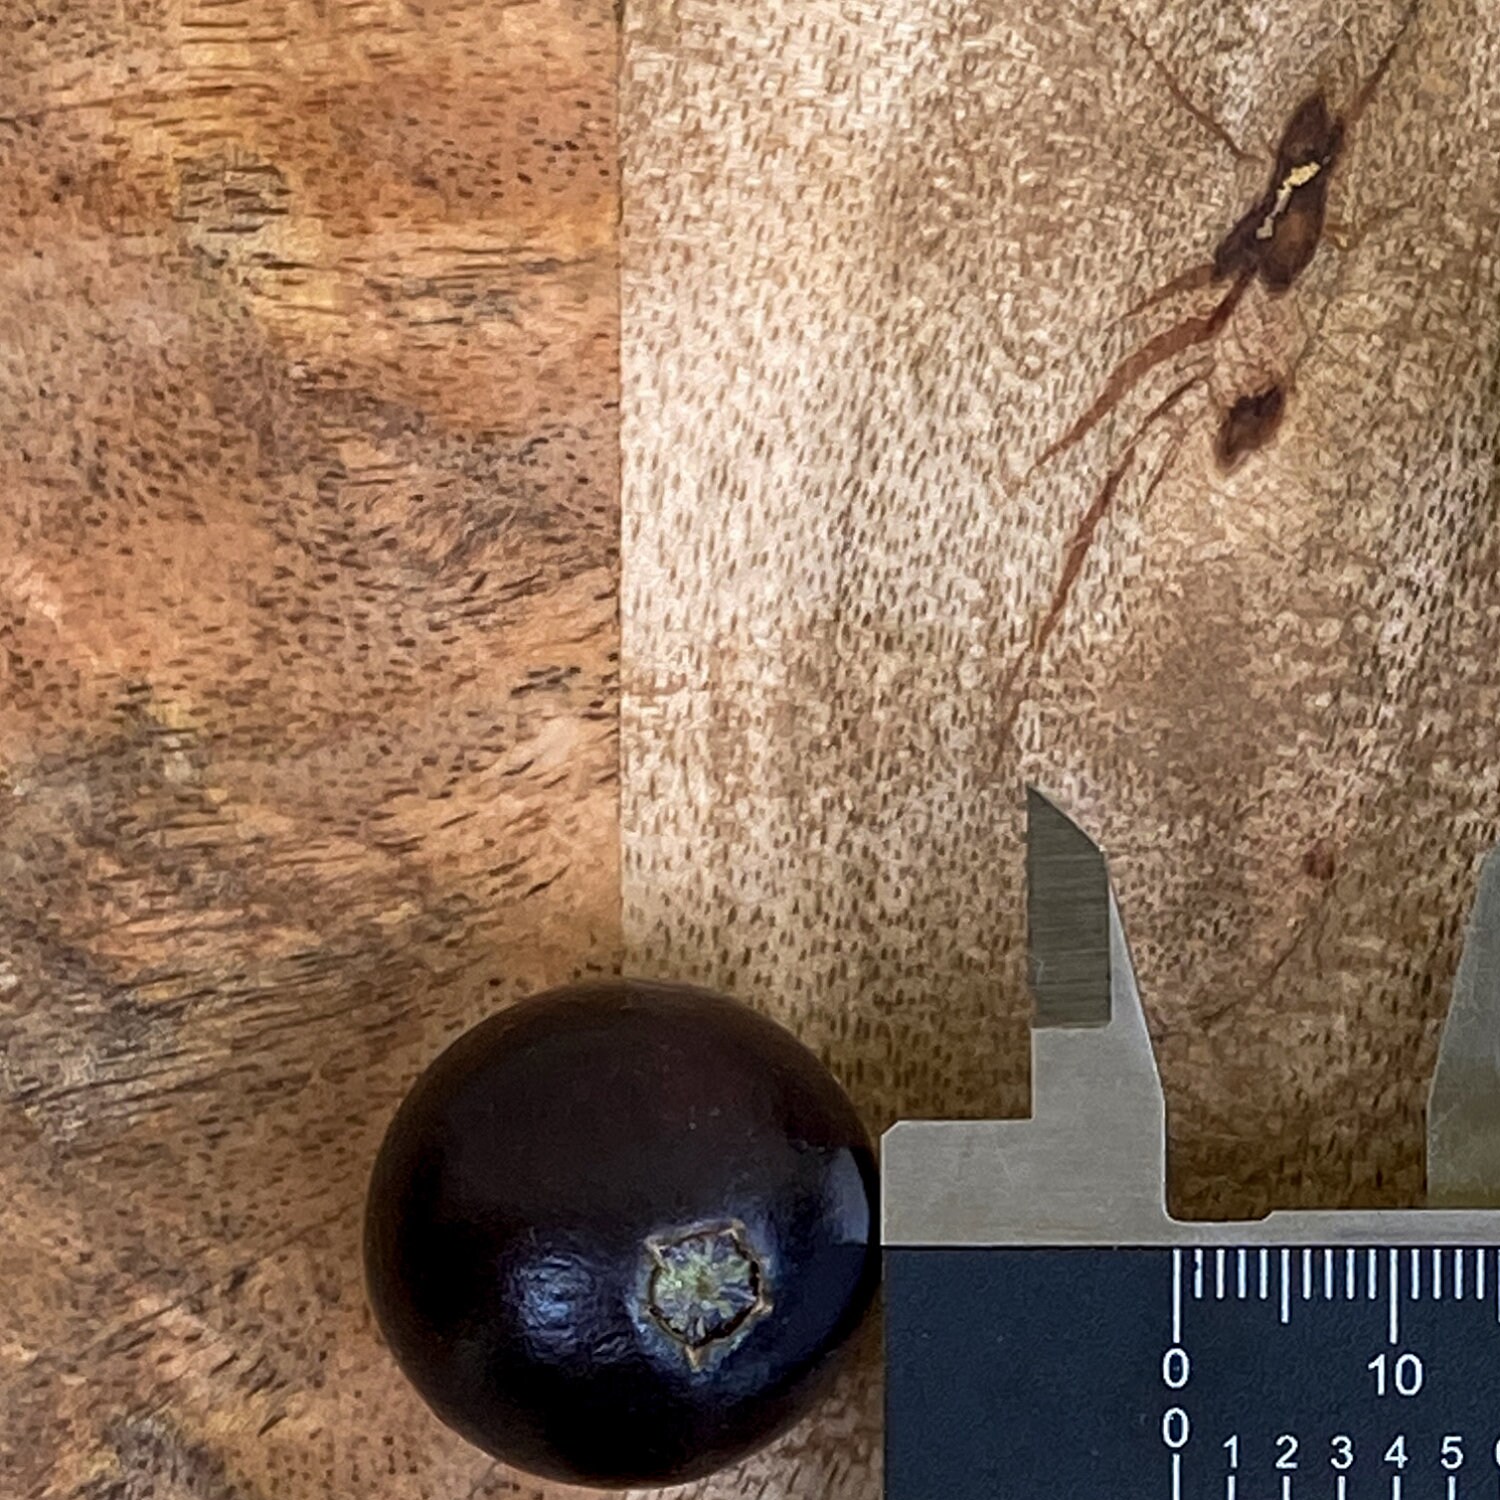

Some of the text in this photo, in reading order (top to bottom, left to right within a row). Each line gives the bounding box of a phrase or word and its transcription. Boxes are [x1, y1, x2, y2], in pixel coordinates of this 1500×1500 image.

[1163, 1347, 1190, 1389] 0
[1367, 1353, 1424, 1397] 10
[1162, 1407, 1189, 1449] 0
[1222, 1435, 1239, 1469] 1
[1275, 1435, 1299, 1470] 2
[1330, 1436, 1355, 1471] 3
[1384, 1435, 1408, 1470] 4
[1440, 1436, 1464, 1471] 5
